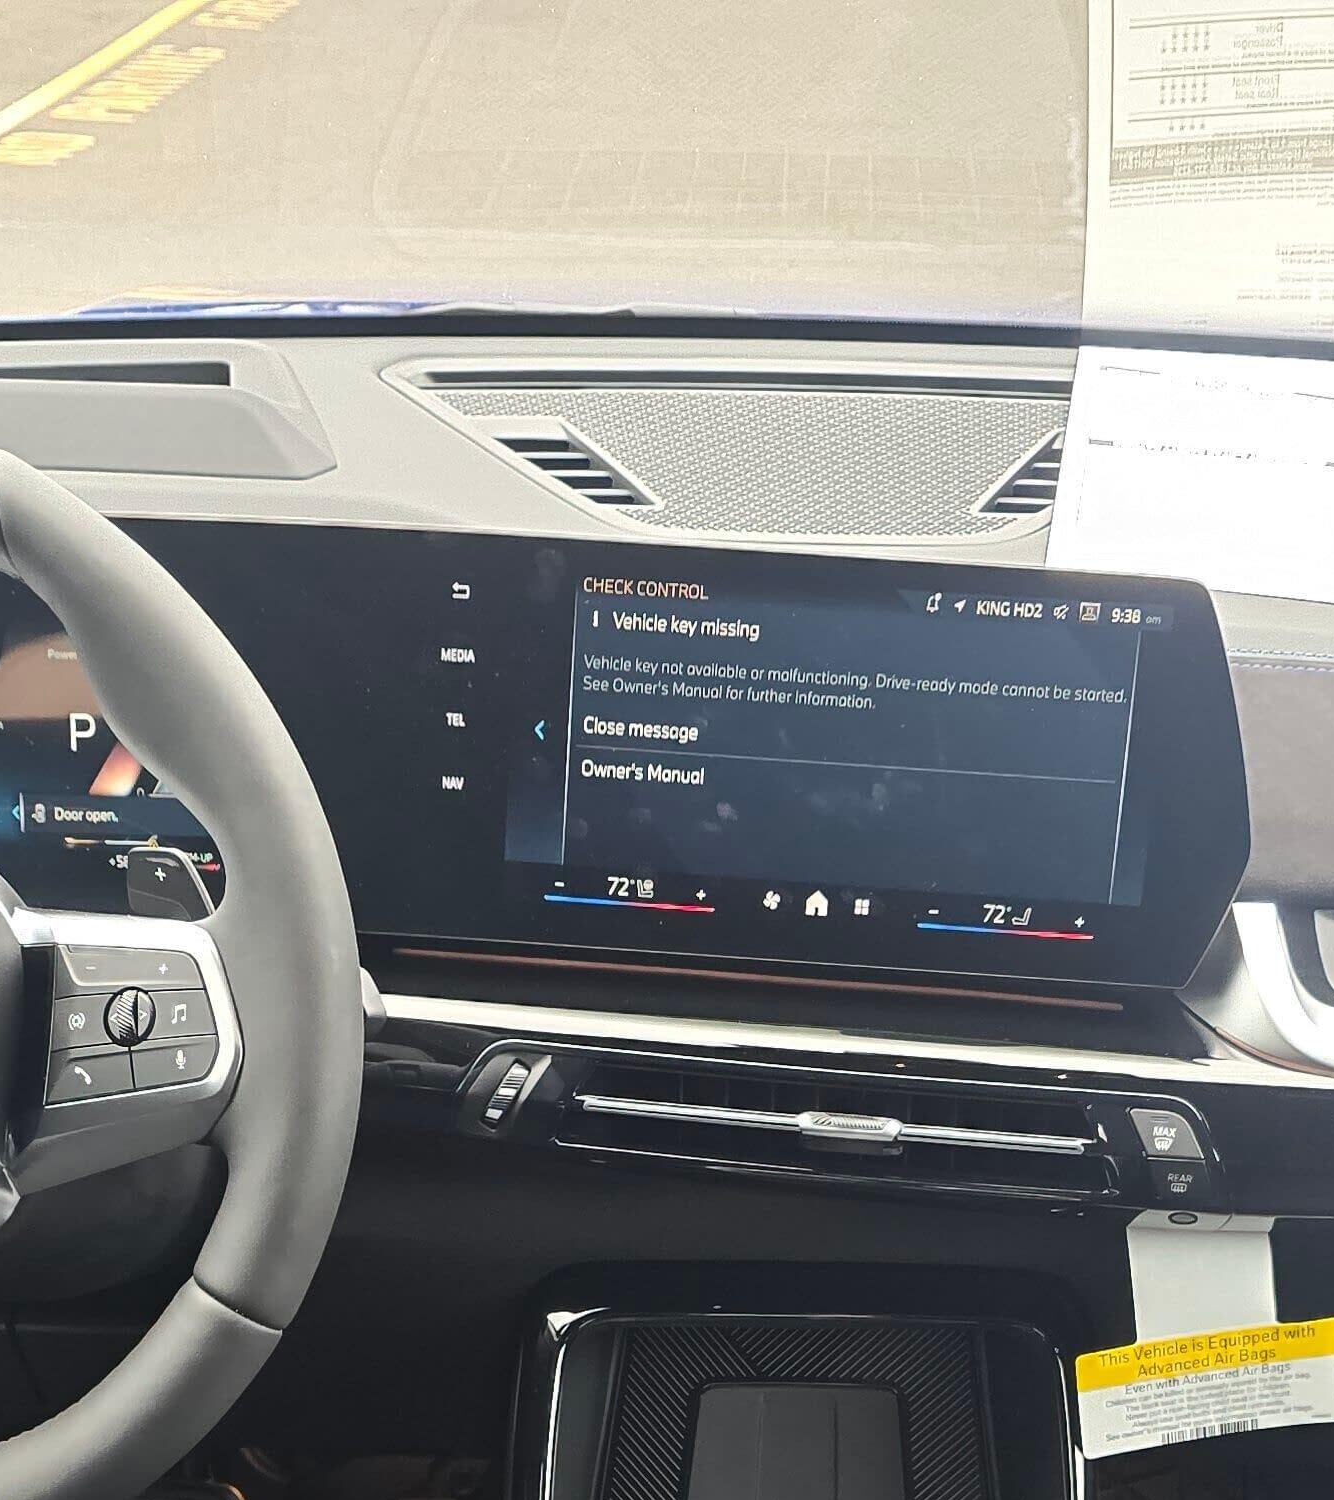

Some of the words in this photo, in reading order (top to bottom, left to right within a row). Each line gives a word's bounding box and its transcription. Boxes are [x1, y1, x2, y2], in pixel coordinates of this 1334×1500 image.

[583, 576, 634, 595] CHECK
[637, 580, 709, 600] CONTROL
[976, 600, 1010, 617] KING
[1014, 602, 1043, 618] HD2
[1111, 608, 1141, 624] 9:38
[612, 611, 667, 633] Vehicle
[670, 615, 697, 638] key
[701, 618, 760, 642] missing
[441, 648, 475, 663] MEDIA
[583, 676, 609, 692] See
[613, 677, 668, 696] Owner's
[672, 682, 722, 700] Manual
[726, 685, 743, 701] for
[747, 686, 792, 704] further
[584, 654, 631, 673] Vehicle
[635, 657, 658, 677] key
[662, 660, 684, 676] not
[687, 662, 747, 680] available
[751, 667, 765, 681] or
[768, 668, 871, 690] malfunctioning.
[875, 673, 956, 695] Drive-ready
[958, 680, 999, 696] mode
[1002, 682, 1050, 699] cannot
[1053, 685, 1071, 700] be
[1074, 686, 1128, 704] started.
[69, 712, 96, 752] P
[446, 712, 466, 727] TEL
[583, 716, 625, 737] Close
[629, 723, 699, 744] message
[442, 776, 465, 791] NAV
[581, 759, 643, 781] Owner's
[647, 764, 705, 785] Manual
[54, 807, 84, 822] Door
[1153, 1126, 1177, 1138] MAX
[1167, 1172, 1193, 1183] REAR
[1098, 1353, 1130, 1368] This
[1134, 1343, 1188, 1361] Vehicle
[1192, 1340, 1204, 1352] is
[1208, 1328, 1279, 1350] Equipped
[1283, 1325, 1316, 1341] with
[1137, 1357, 1210, 1377] Advanced
[1214, 1352, 1234, 1367] Air
[1240, 1347, 1276, 1364] Bags
[1125, 1383, 1153, 1395] Even
[1156, 1378, 1179, 1389] with
[1182, 1368, 1239, 1385] Advanced
[1242, 1366, 1258, 1376] Air
[1261, 1362, 1291, 1375] Bags
